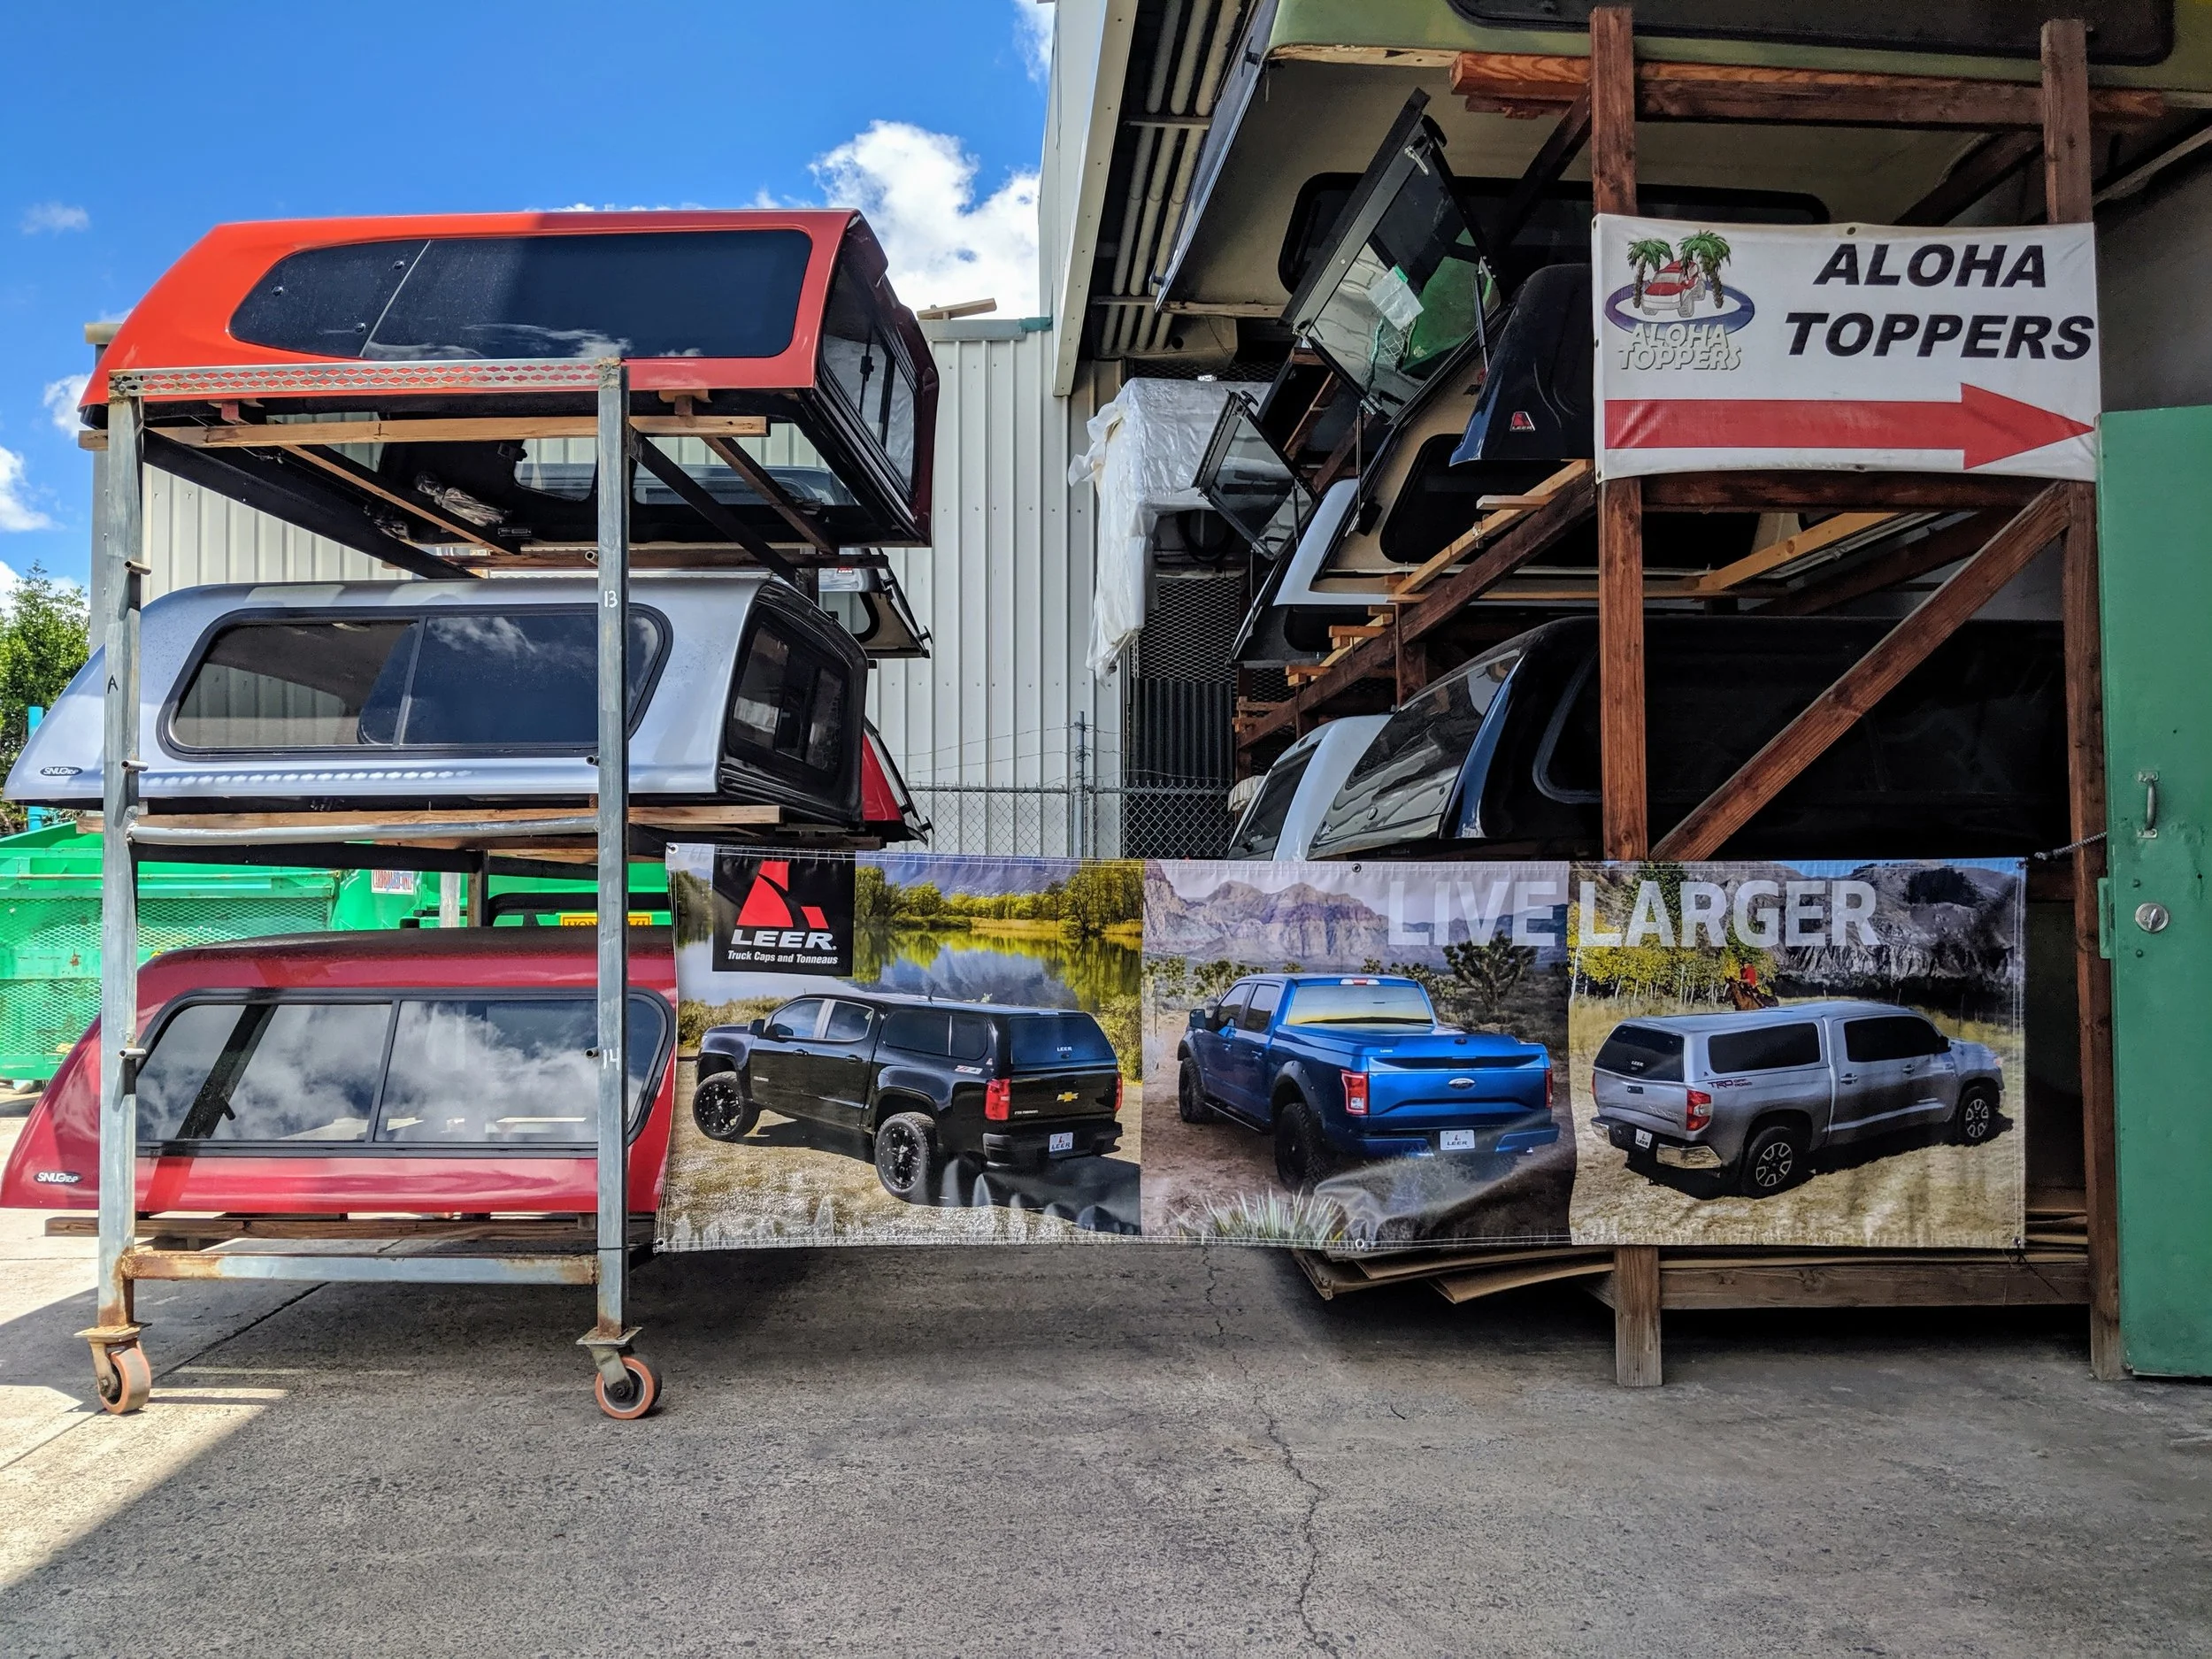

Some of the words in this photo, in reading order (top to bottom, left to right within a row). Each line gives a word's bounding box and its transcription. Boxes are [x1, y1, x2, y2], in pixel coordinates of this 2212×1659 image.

[1812, 243, 2047, 288] ALOHA
[1628, 323, 1729, 349] ALOHA
[1784, 311, 2095, 361] TOPPERS
[1618, 345, 1741, 371] TOPPERS
[603, 590, 618, 608] 13
[107, 674, 119, 695] A
[1388, 880, 1559, 947] LIVE
[1579, 880, 1883, 949] LARGER
[731, 929, 836, 950] LEER
[727, 950, 752, 961] Truck
[754, 951, 776, 964] Caps
[777, 953, 794, 964] and
[796, 954, 839, 964] Tonneaus
[603, 1047, 620, 1071] 14
[1051, 1141, 1071, 1150] LEER
